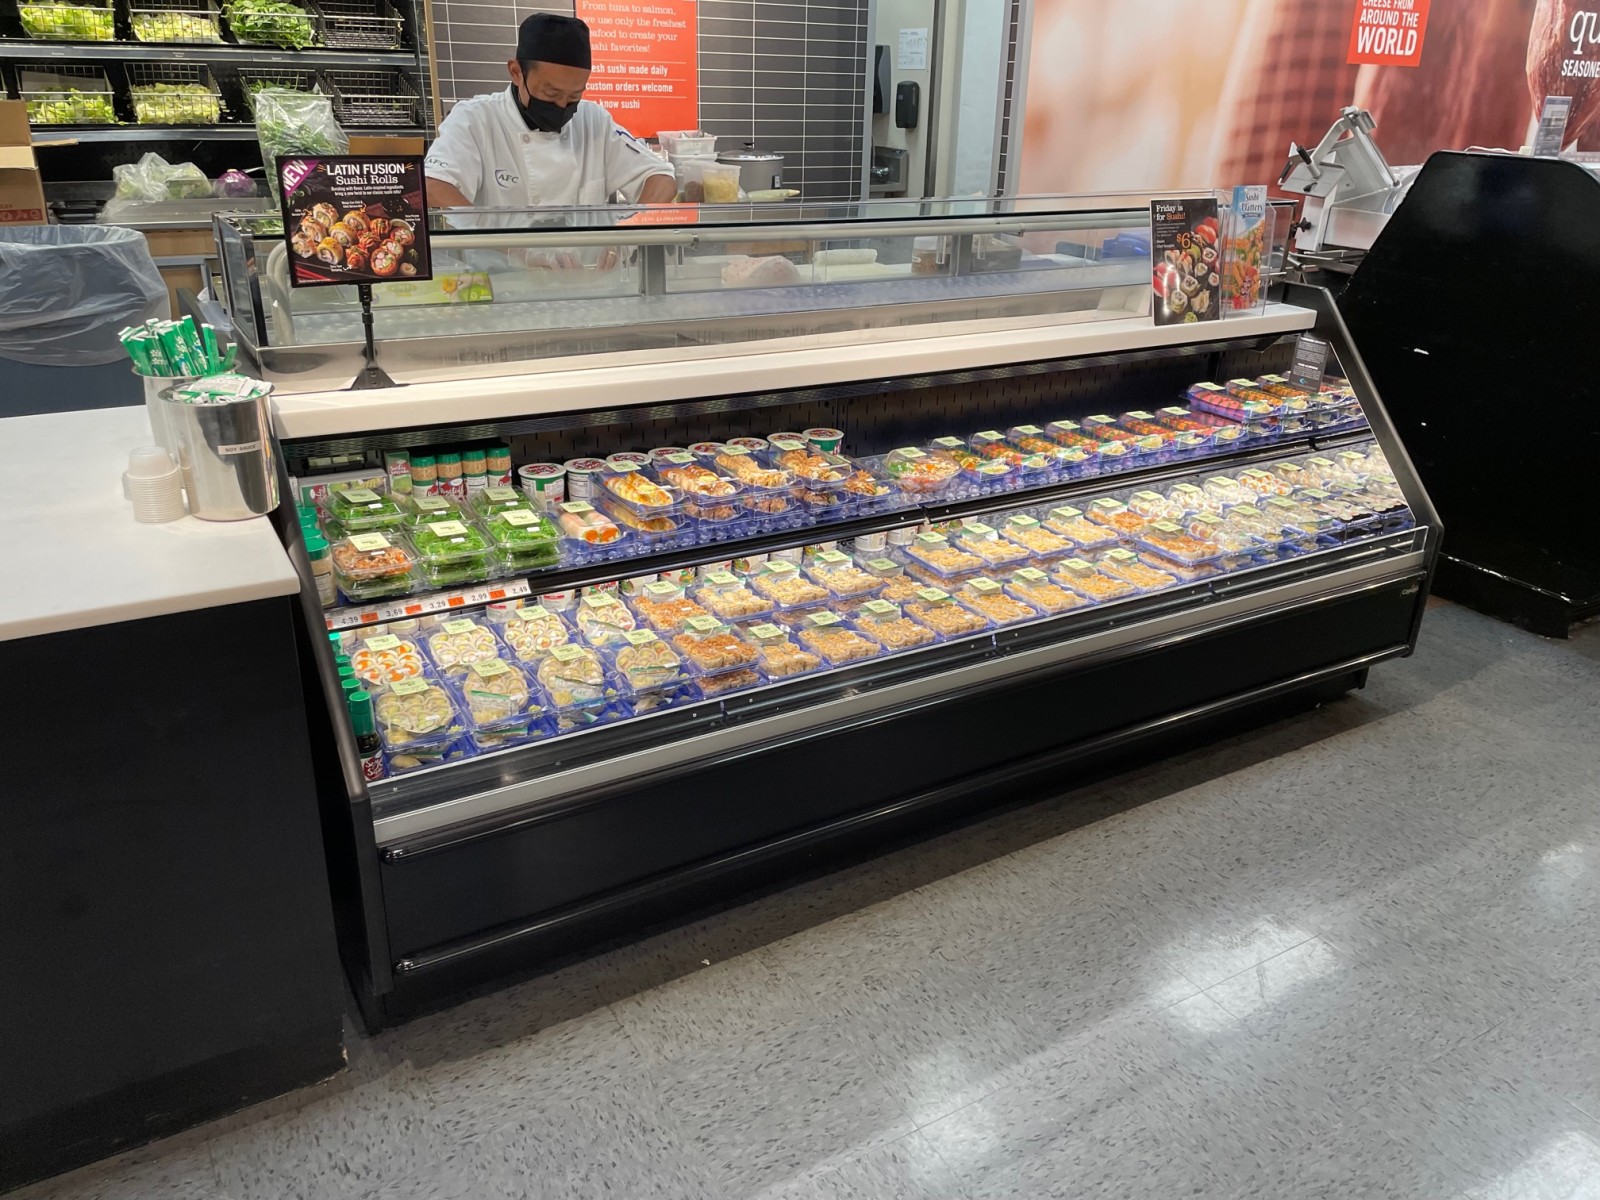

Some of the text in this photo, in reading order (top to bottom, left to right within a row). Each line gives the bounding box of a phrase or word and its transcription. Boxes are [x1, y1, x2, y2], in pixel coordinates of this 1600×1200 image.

[582, 1, 676, 15] From tuna to salmon,
[1393, 0, 1414, 10] FROM
[598, 17, 613, 25] use
[615, 17, 634, 28] only
[637, 18, 651, 27] the
[653, 19, 687, 28] freshest
[1360, 8, 1420, 28] AROUND THE
[630, 32, 656, 40] create
[657, 33, 678, 42] your
[1357, 26, 1417, 56] WORLD
[610, 42, 651, 53] favorites!
[607, 64, 627, 74] sushi
[628, 65, 649, 75] made
[651, 65, 668, 77] daily
[585, 81, 673, 93] custom orders welcome
[621, 99, 640, 109] sushi
[428, 158, 448, 168] AFC
[326, 163, 406, 176] LATIN FUSION
[283, 159, 309, 191] NEW
[335, 174, 399, 186] Sushi Rolls
[498, 174, 519, 184] AFC
[1156, 204, 1176, 213] Friday
[1156, 212, 1186, 221] for Sushi!
[1176, 232, 1191, 248] $6
[512, 585, 528, 594] 2.49
[471, 592, 487, 602] 2.99
[429, 600, 446, 609] 3.29
[385, 608, 403, 617] 3.69
[341, 616, 358, 625] 4.39
